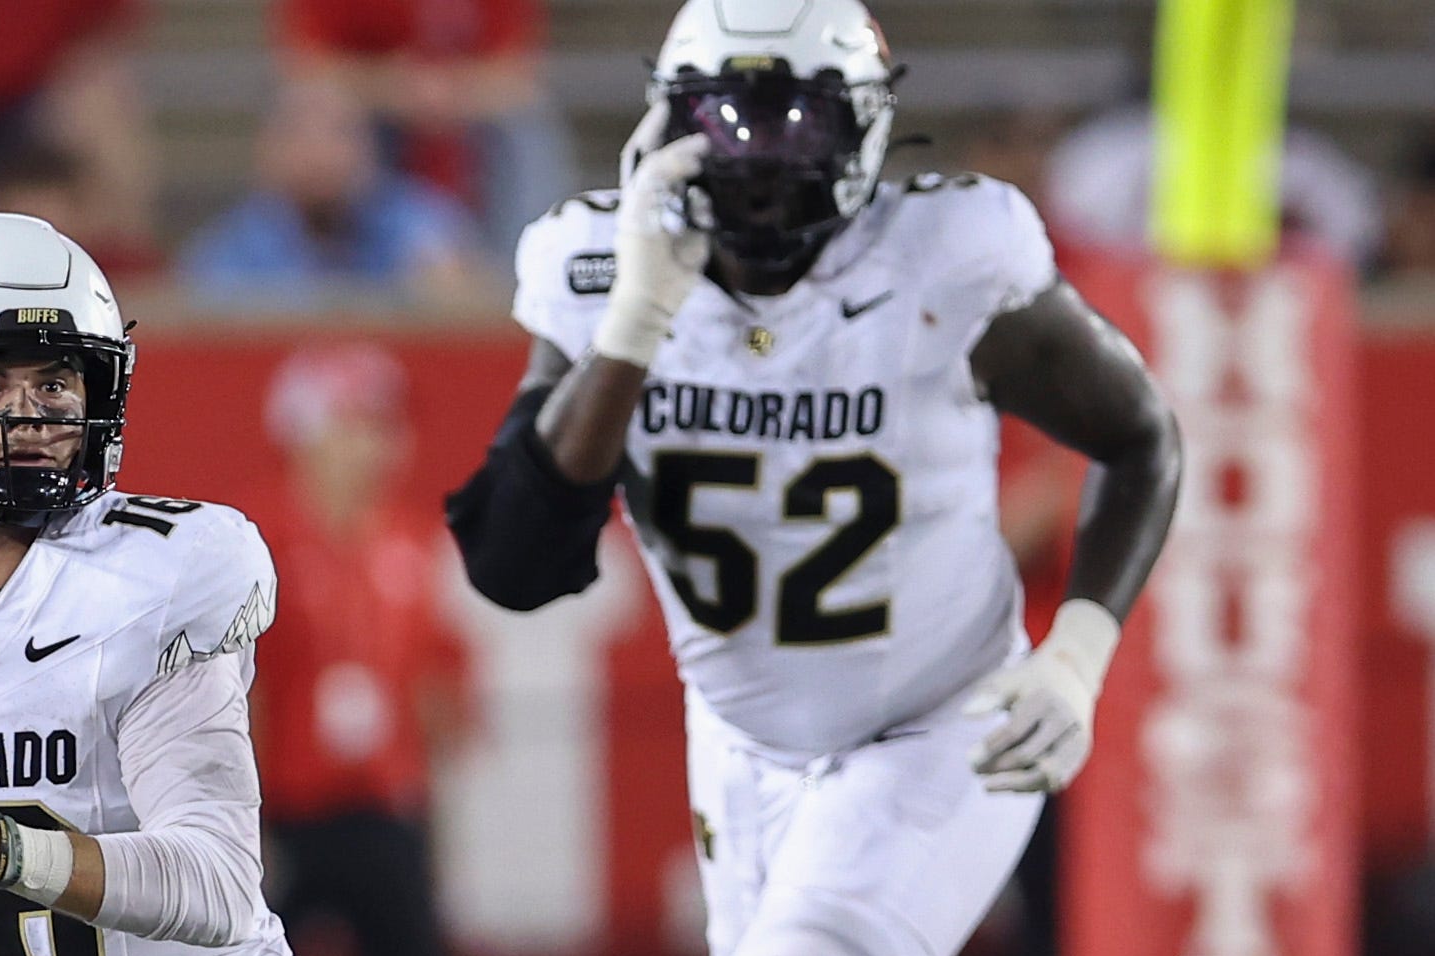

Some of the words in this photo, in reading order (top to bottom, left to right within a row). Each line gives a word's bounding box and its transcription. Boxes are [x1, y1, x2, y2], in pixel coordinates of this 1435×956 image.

[17, 308, 59, 324] BUFFS
[643, 384, 883, 440] COLORADO
[655, 450, 902, 647] 52
